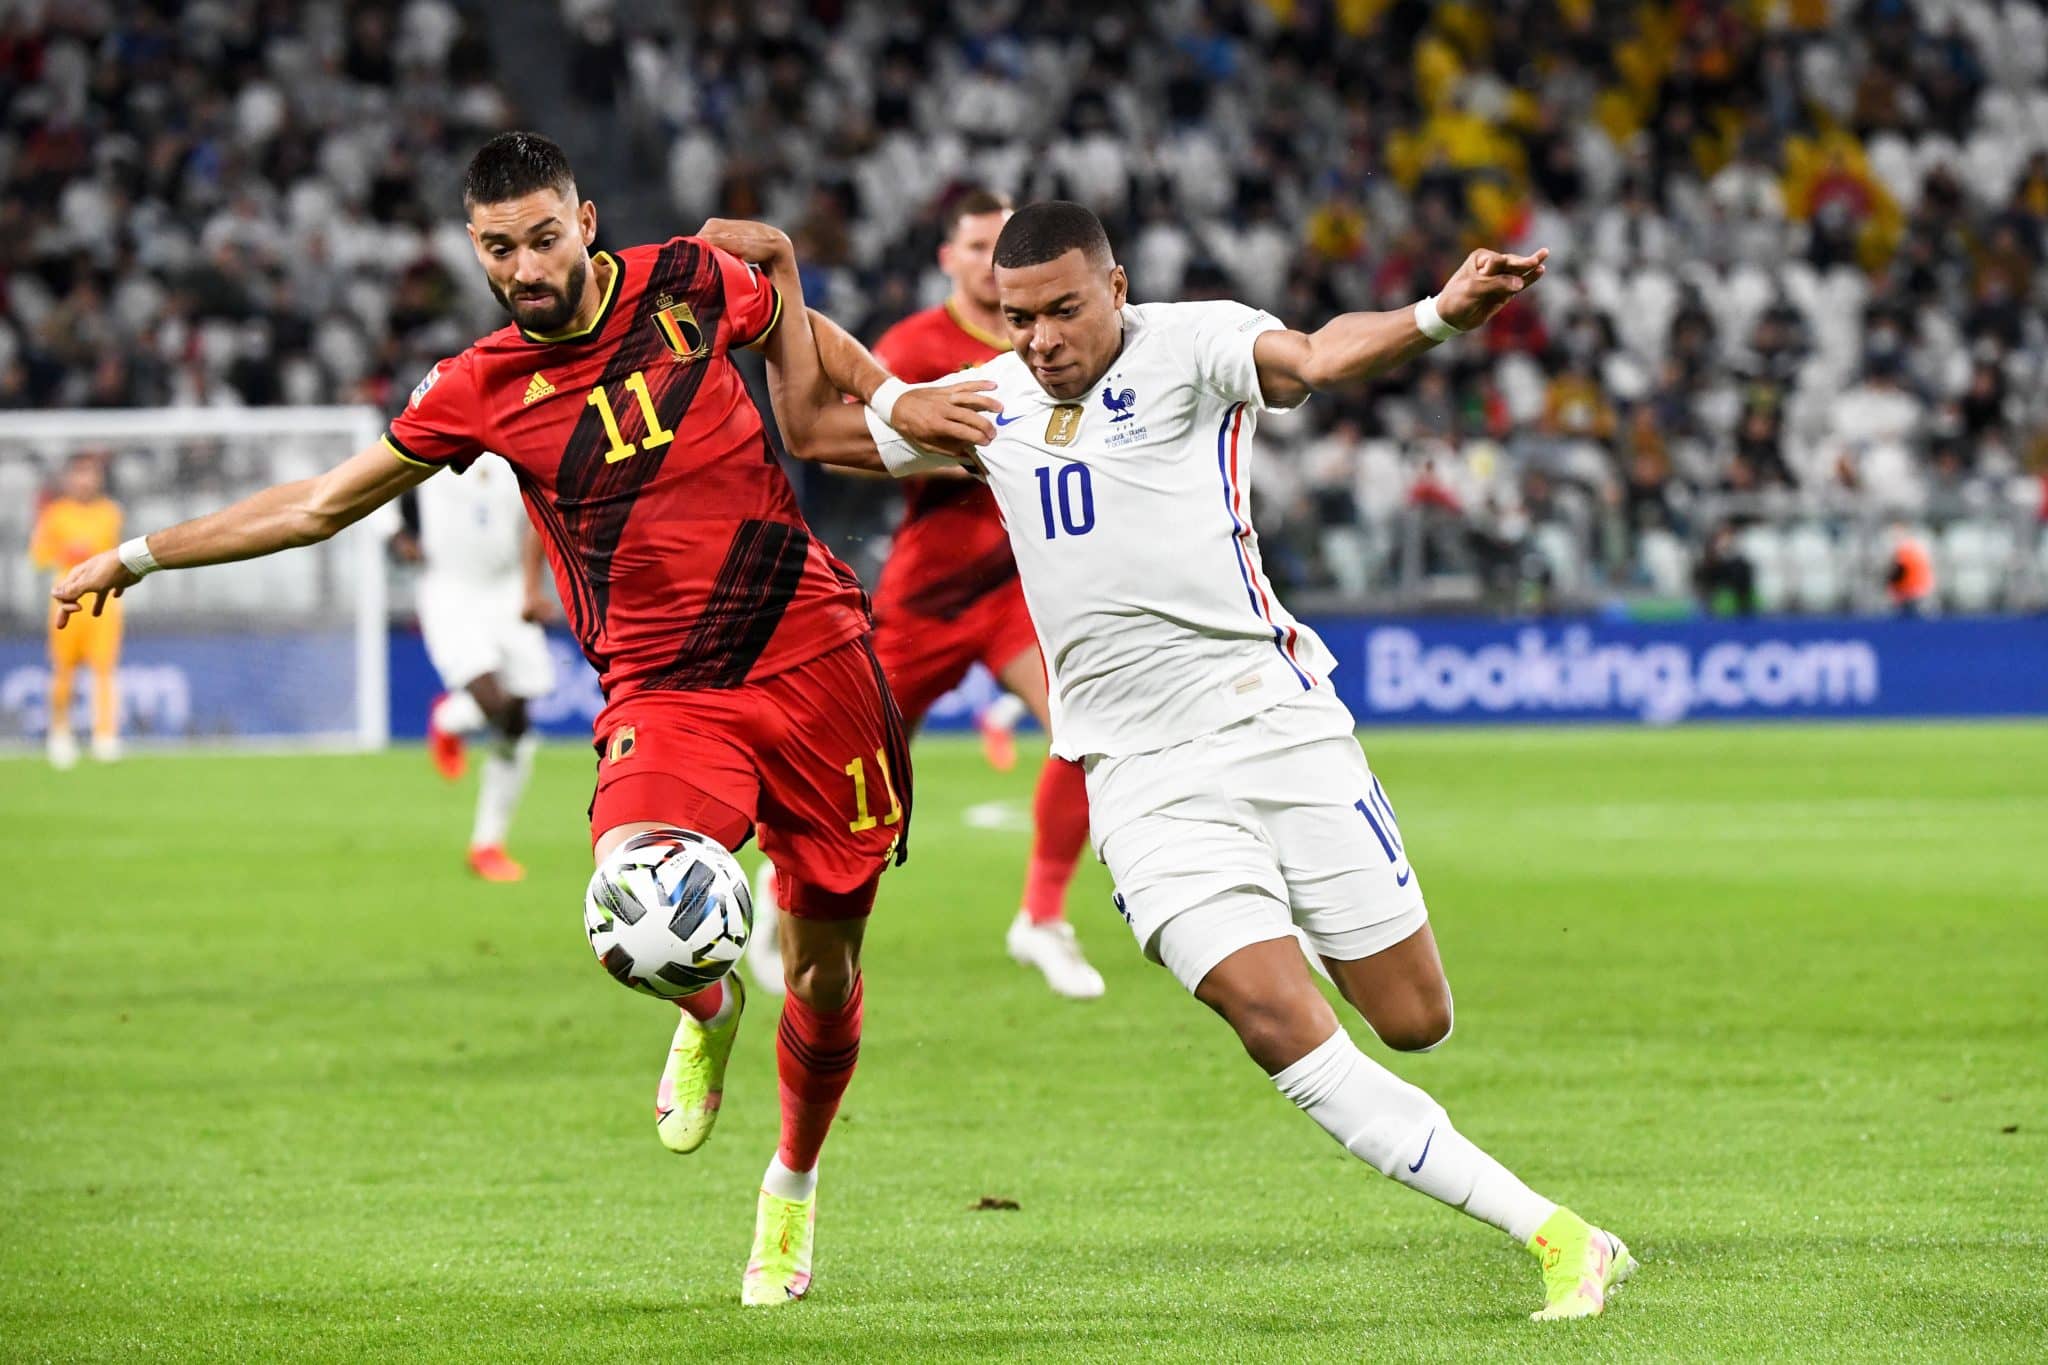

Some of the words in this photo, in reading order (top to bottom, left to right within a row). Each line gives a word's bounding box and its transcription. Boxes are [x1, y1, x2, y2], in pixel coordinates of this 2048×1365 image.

[524, 385, 556, 404] adidas
[587, 371, 674, 464] 11
[1036, 462, 1095, 540] 10
[1366, 628, 1877, 722] Booking.com
[846, 748, 901, 833] 11
